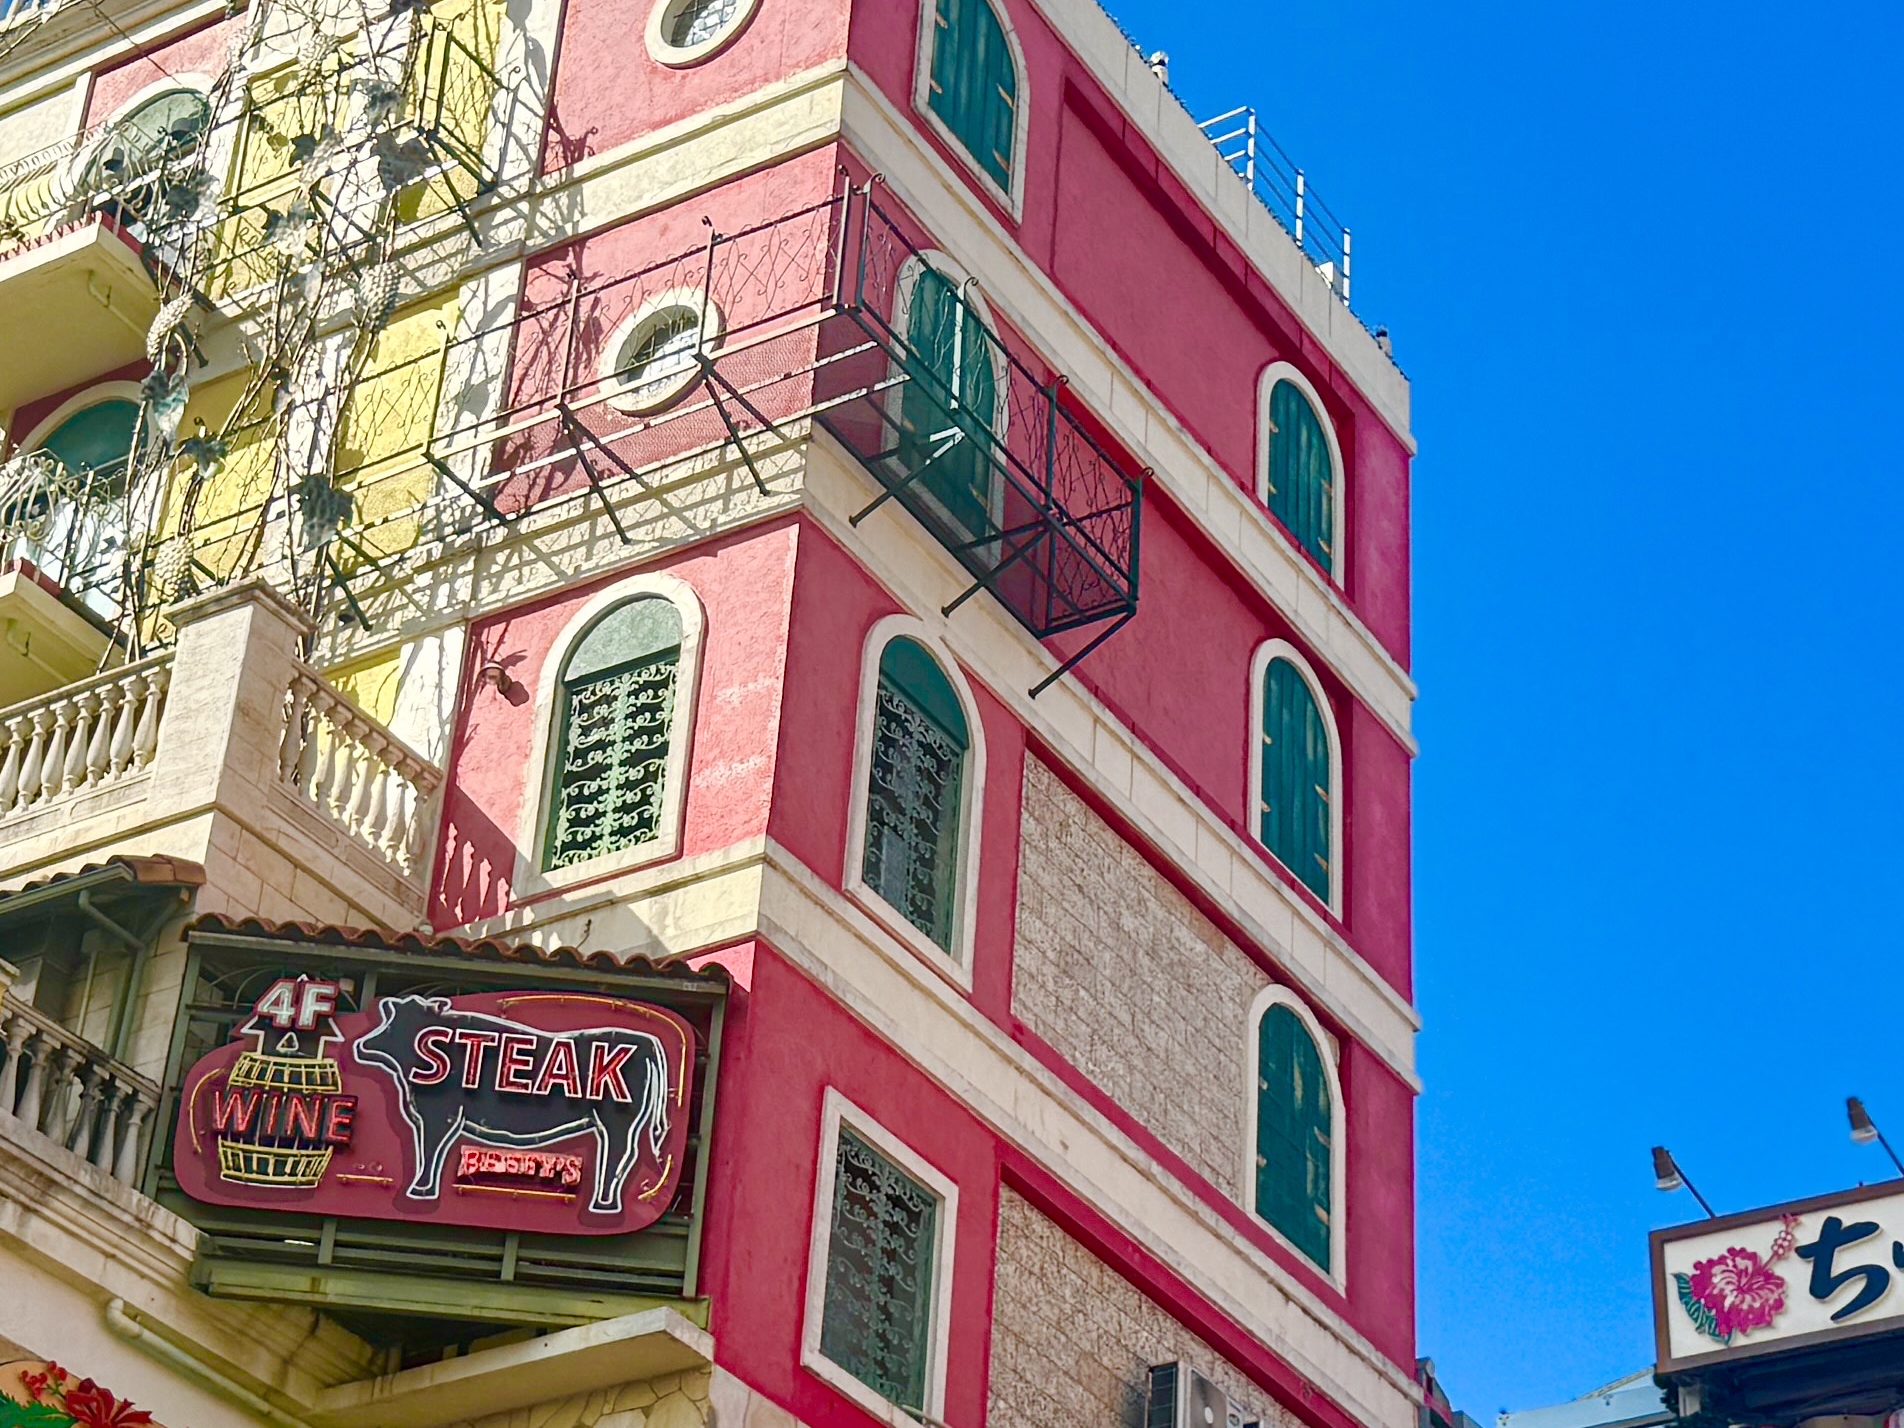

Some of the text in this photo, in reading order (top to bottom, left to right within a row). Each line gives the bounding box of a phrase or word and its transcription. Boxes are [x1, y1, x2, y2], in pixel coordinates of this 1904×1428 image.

[257, 978, 339, 1029] 4F
[409, 1026, 638, 1104] STEAK
[212, 1089, 358, 1145] WINE
